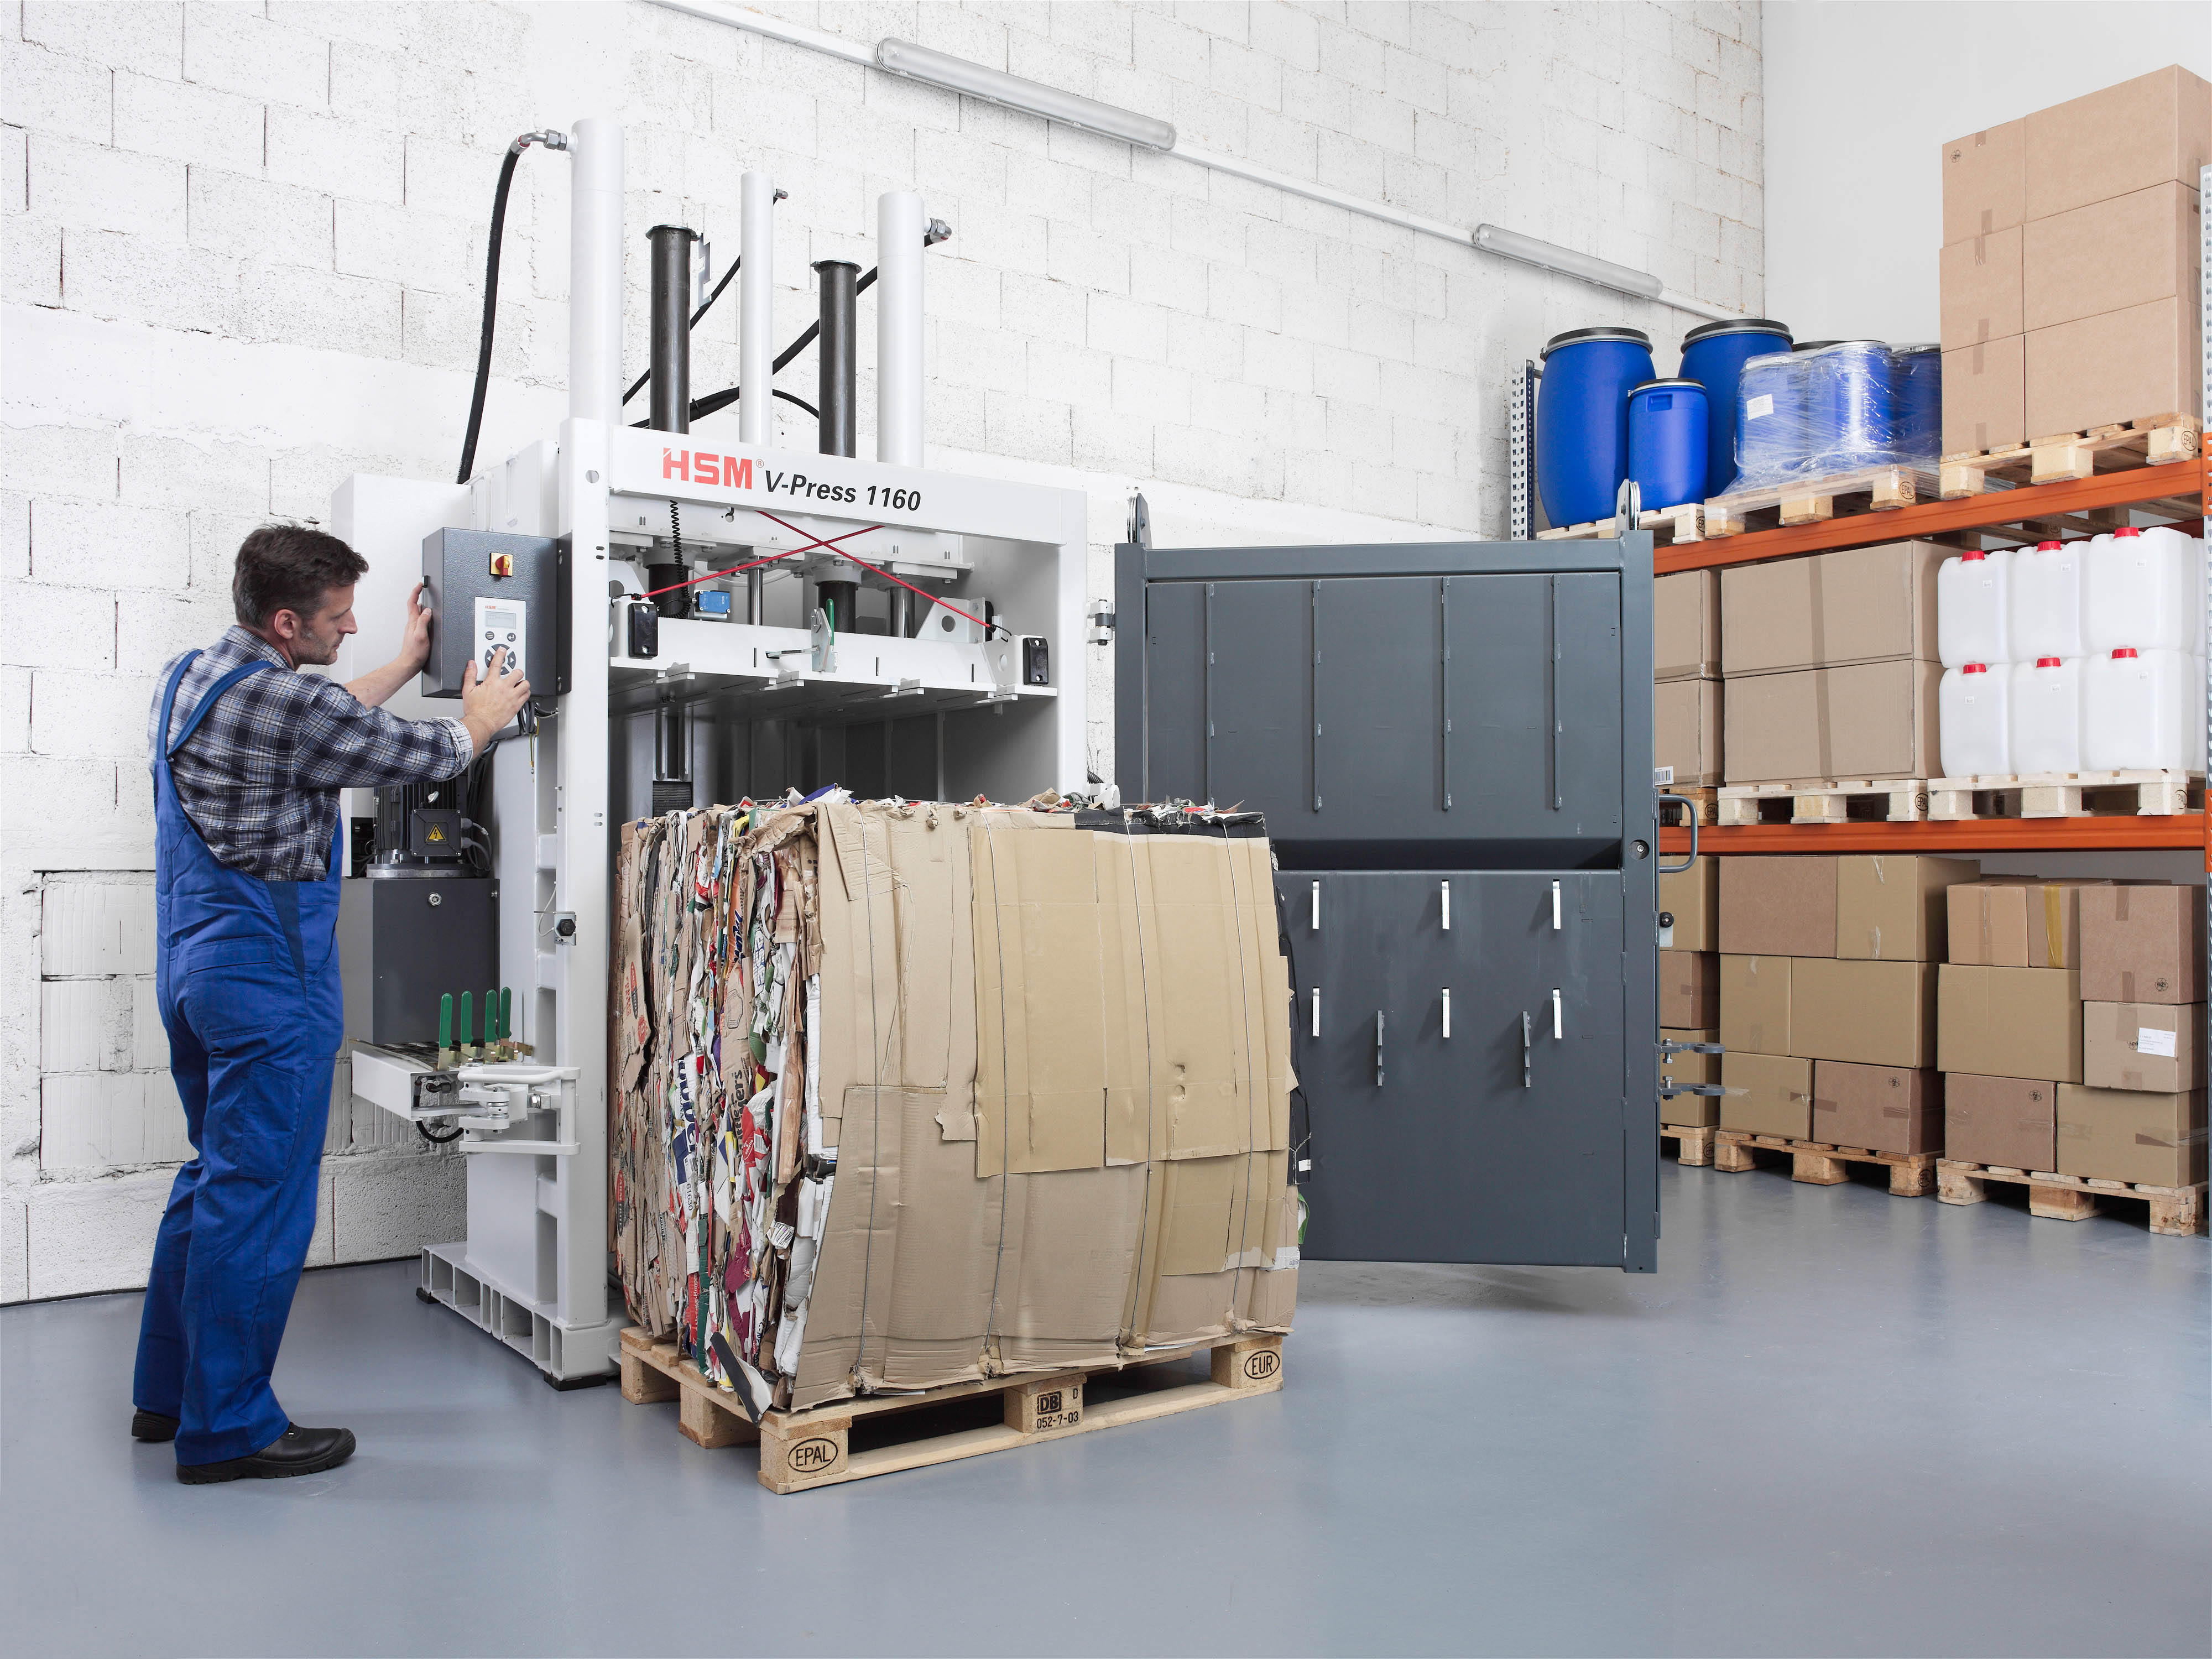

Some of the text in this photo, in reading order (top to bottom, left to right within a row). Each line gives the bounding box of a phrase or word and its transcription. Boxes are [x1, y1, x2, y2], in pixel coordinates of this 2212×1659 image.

[765, 470, 856, 503] V-Press
[867, 486, 921, 511] 1160
[1901, 484, 1913, 497] EPAL
[1252, 1355, 1272, 1375] EUR
[1073, 1388, 1078, 1399] D
[1040, 1394, 1059, 1412] DB
[1037, 1411, 1078, 1428] 052-7-03
[796, 1445, 831, 1467] EPAL
